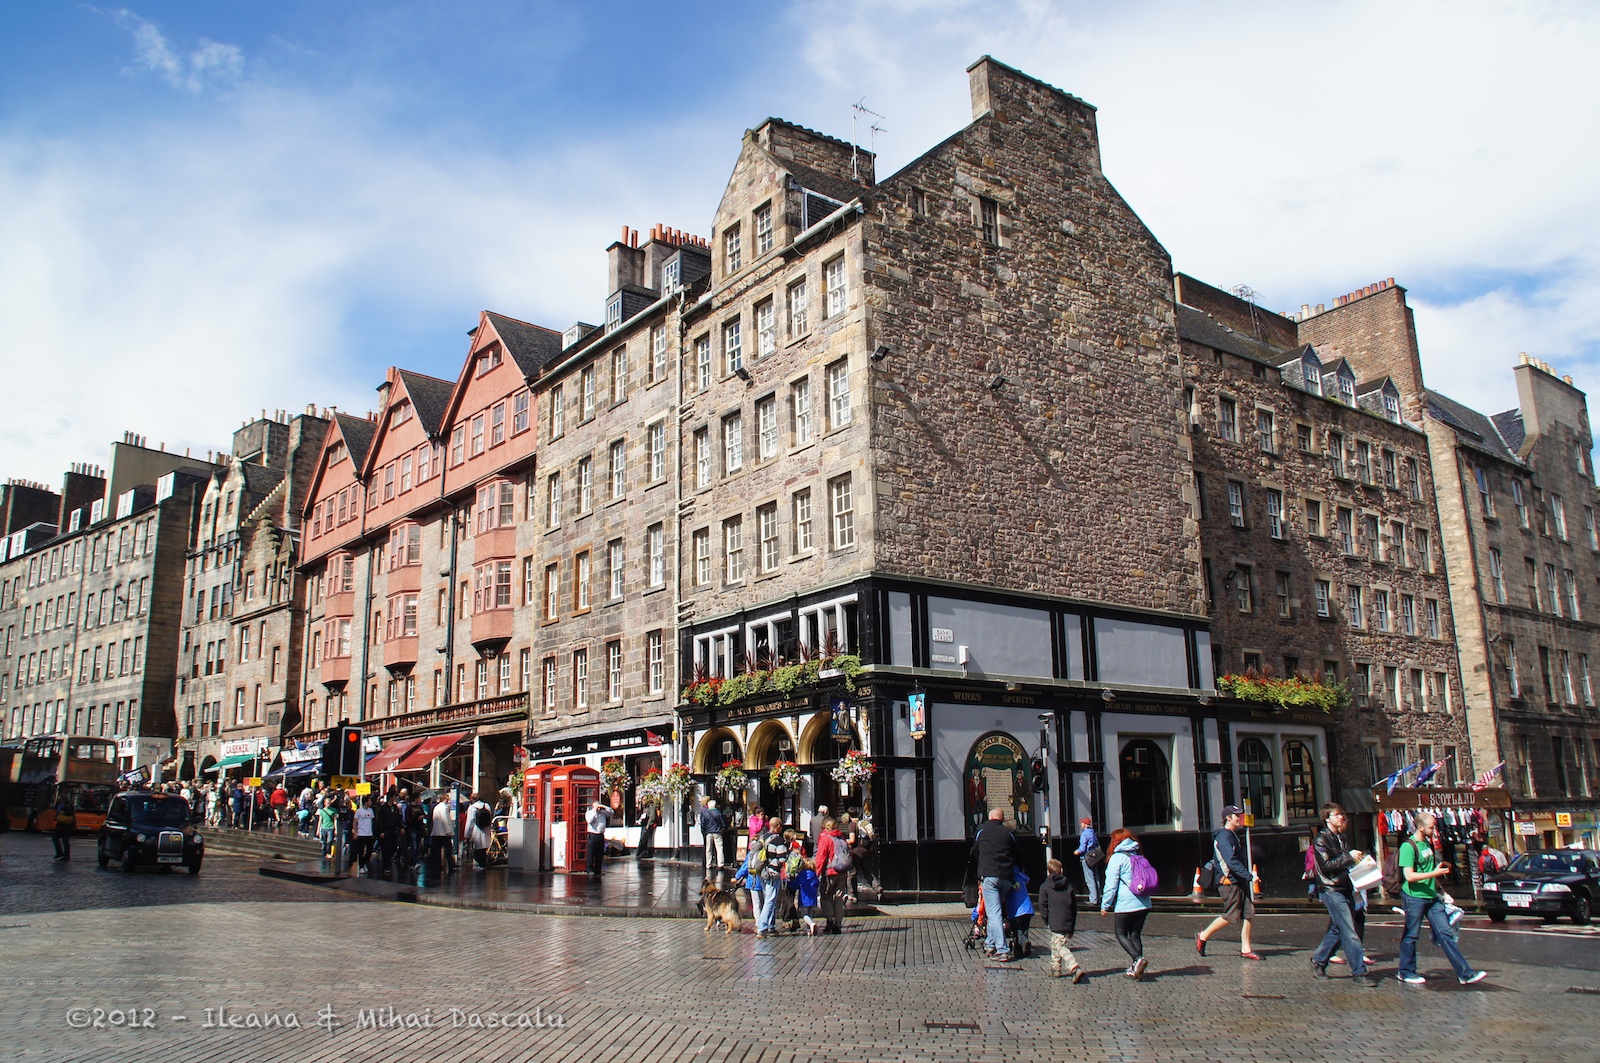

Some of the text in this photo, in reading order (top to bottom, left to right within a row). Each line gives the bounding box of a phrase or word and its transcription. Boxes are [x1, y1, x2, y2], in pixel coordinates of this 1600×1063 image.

[953, 691, 1035, 705] WINES SPIRITS
[1104, 702, 1188, 714] DEACON BRODIE'S TAVERN
[1416, 792, 1476, 807] I SCOTLAND
